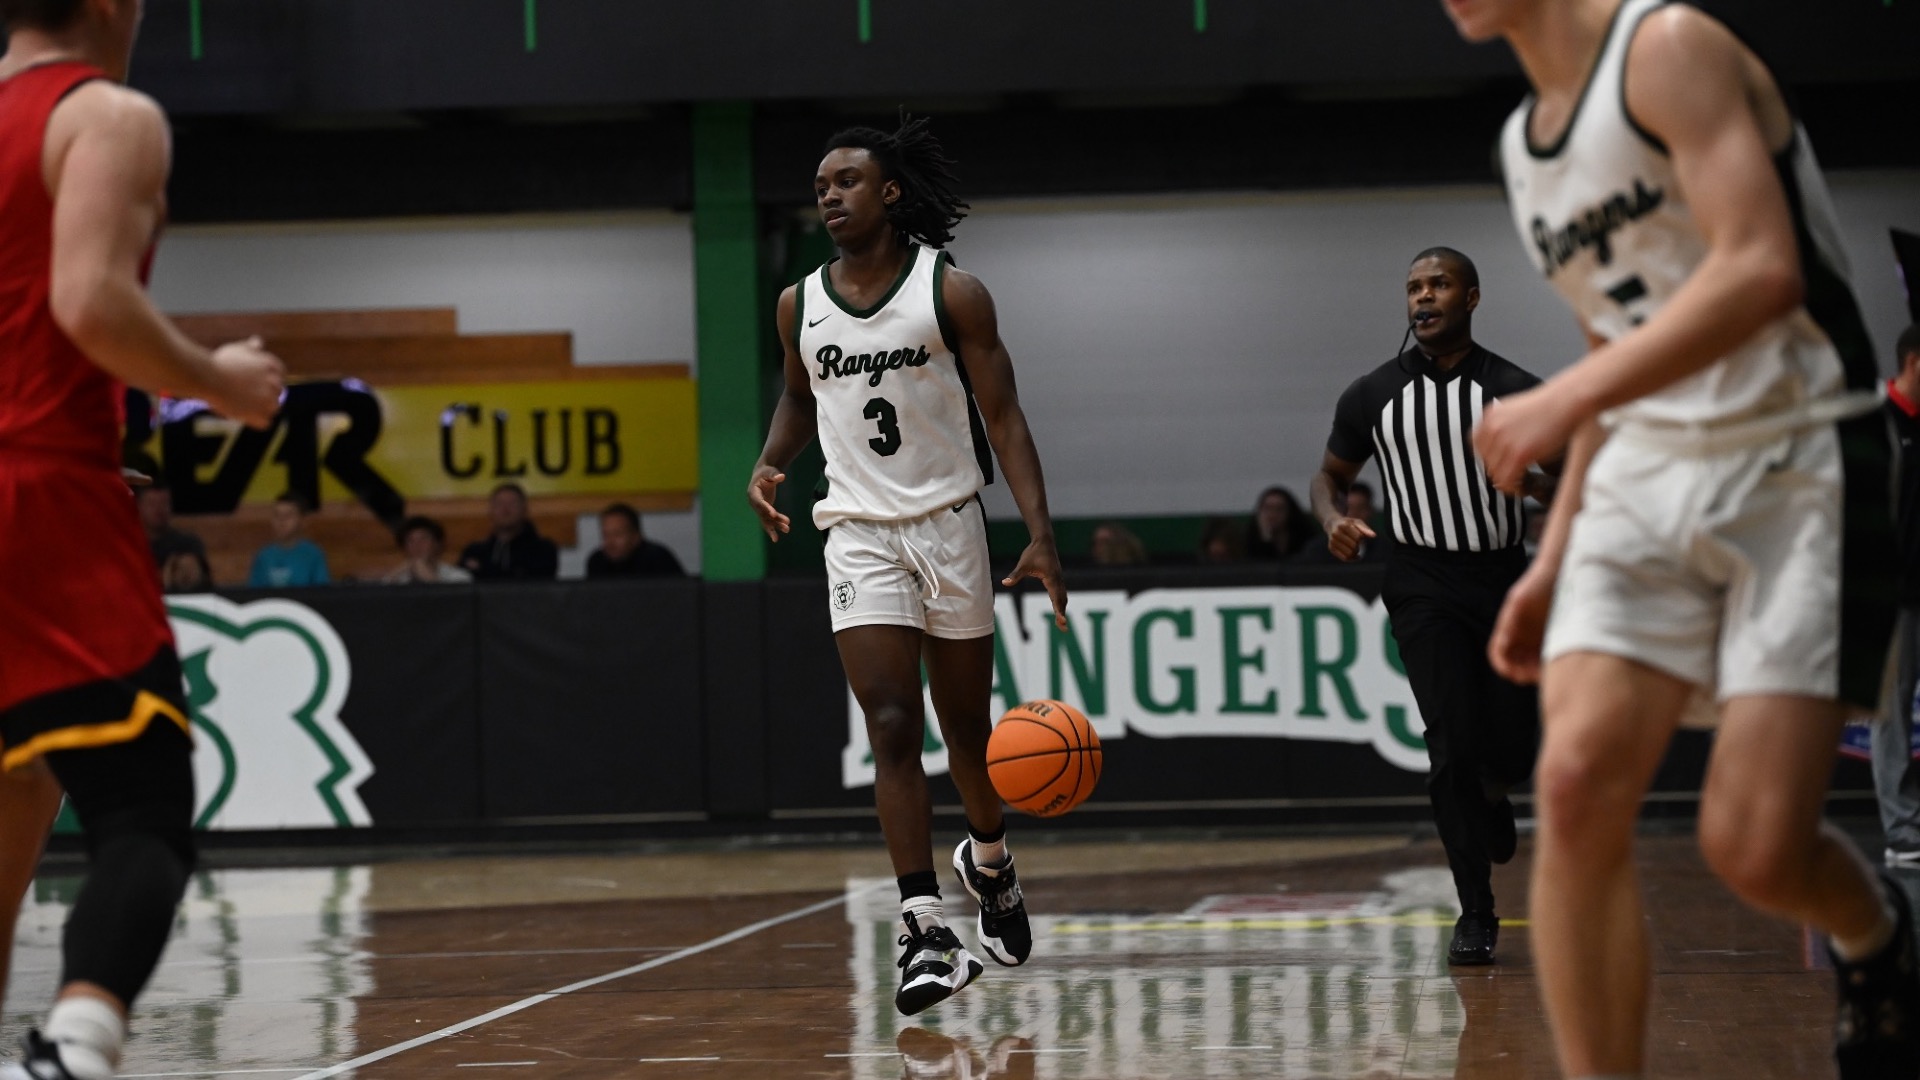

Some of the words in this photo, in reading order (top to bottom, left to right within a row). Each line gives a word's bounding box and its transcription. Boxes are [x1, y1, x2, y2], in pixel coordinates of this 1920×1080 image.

[815, 343, 931, 388] Rangers
[439, 402, 623, 480] CLUB
[862, 396, 902, 458] 3
[862, 604, 1432, 766] NGER
